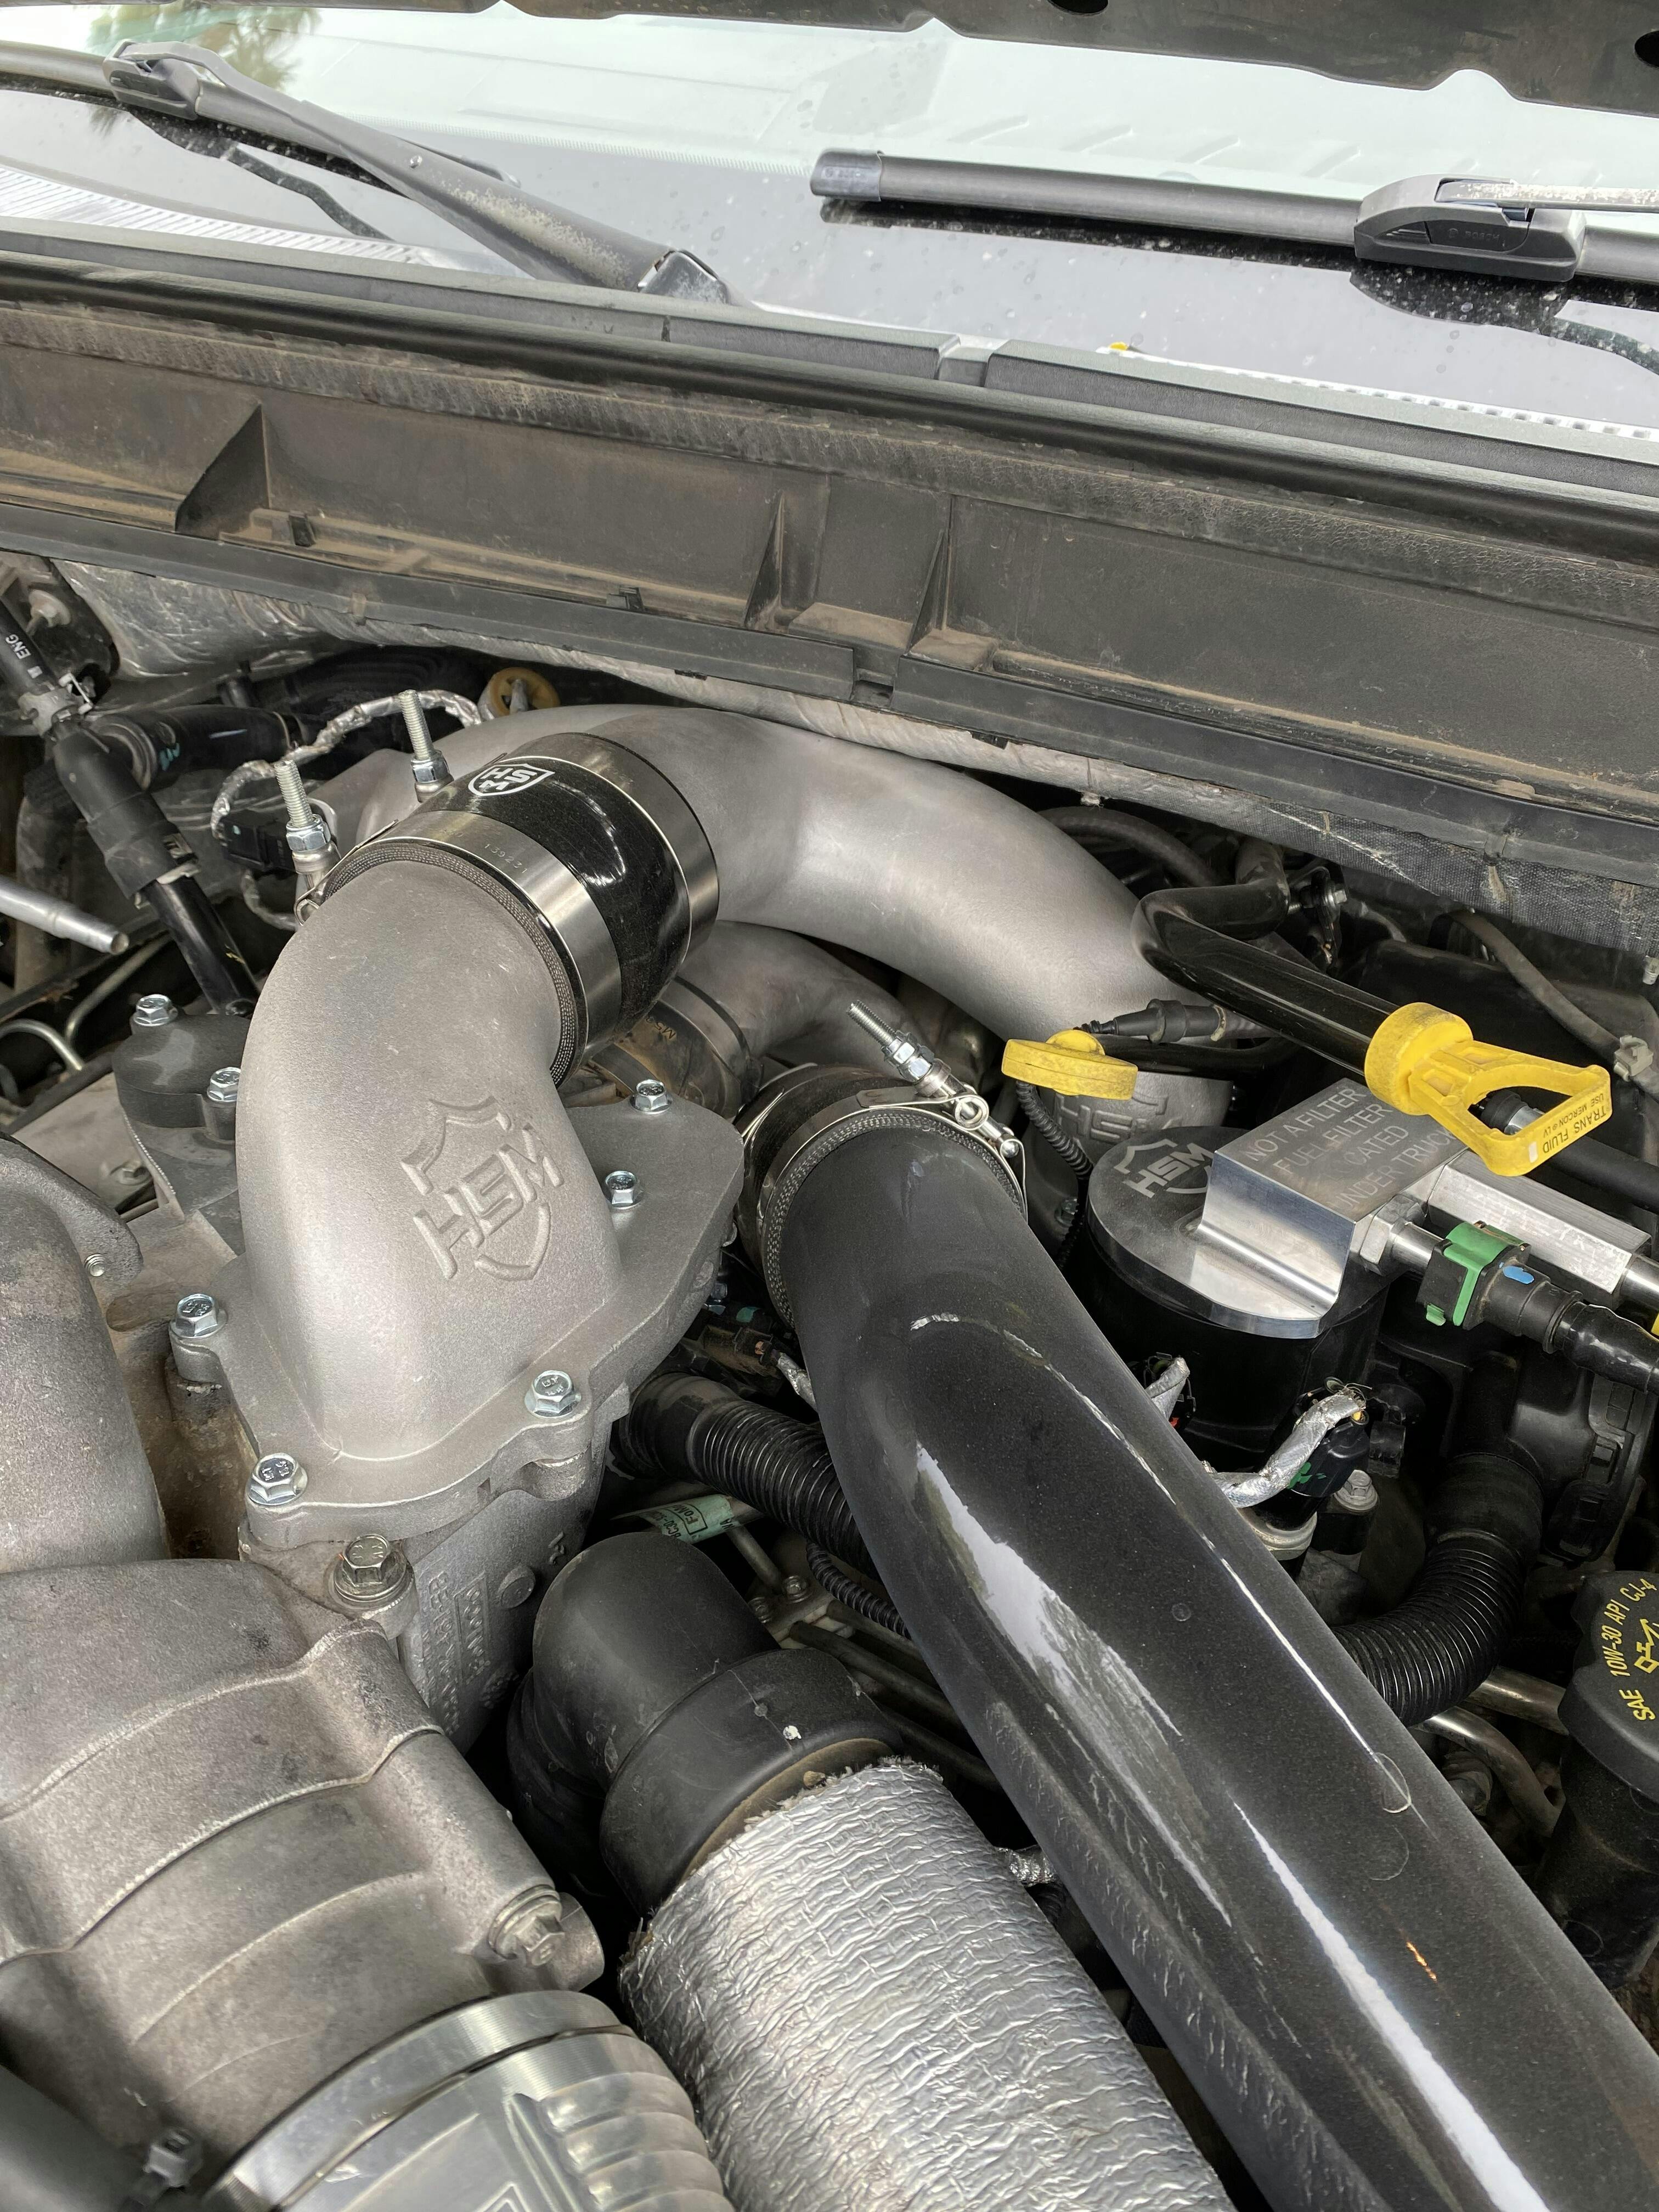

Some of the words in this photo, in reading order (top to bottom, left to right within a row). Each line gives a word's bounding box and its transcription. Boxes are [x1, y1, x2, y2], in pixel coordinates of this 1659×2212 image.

[5, 634, 31, 659] ENG
[484, 843, 528, 874] 139231
[1295, 1088, 1367, 1128] FILTER
[1591, 1093, 1604, 1107] USE
[1283, 1124, 1308, 1138] A
[1573, 1106, 1607, 1133] TRANS
[1245, 1131, 1289, 1161] NOT
[1272, 1142, 1327, 1175] FUEL
[1322, 1103, 1393, 1145] FILTER
[1543, 1128, 1569, 1153] FLUID
[1328, 1165, 1406, 1208] UNDER
[1620, 1578, 1657, 1602] CJ-4
[1603, 1599, 1630, 1626] API
[1601, 1624, 1631, 1677] 10W-30
[1619, 1689, 1657, 1721] SAE
